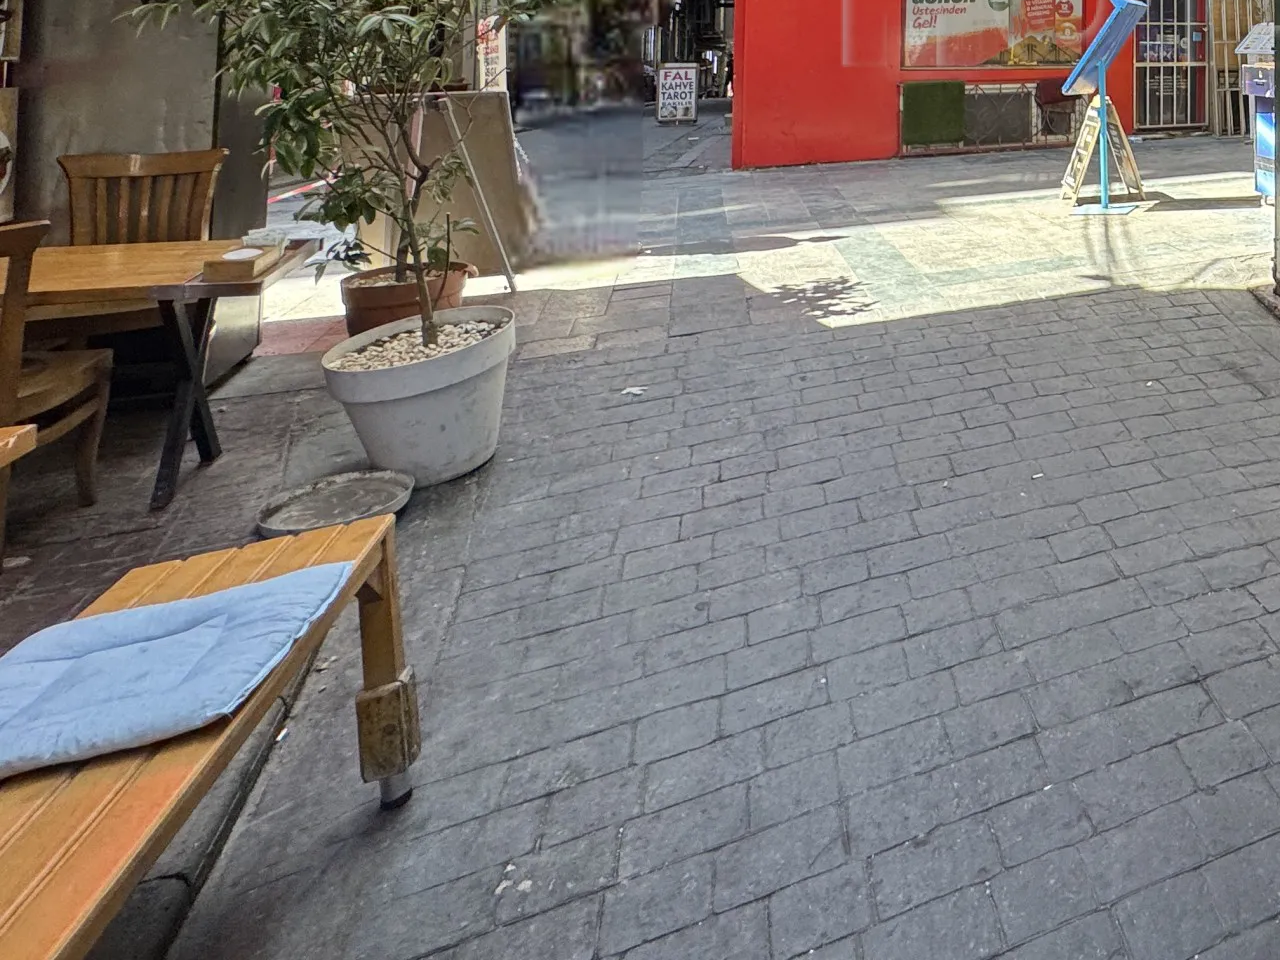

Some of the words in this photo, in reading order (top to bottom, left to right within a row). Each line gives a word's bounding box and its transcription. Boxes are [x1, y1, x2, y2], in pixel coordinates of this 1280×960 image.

[912, 14, 937, 29] Gel!
[664, 71, 693, 81] FAL
[661, 81, 694, 91] KAHVE
[661, 91, 694, 101] TAROT
